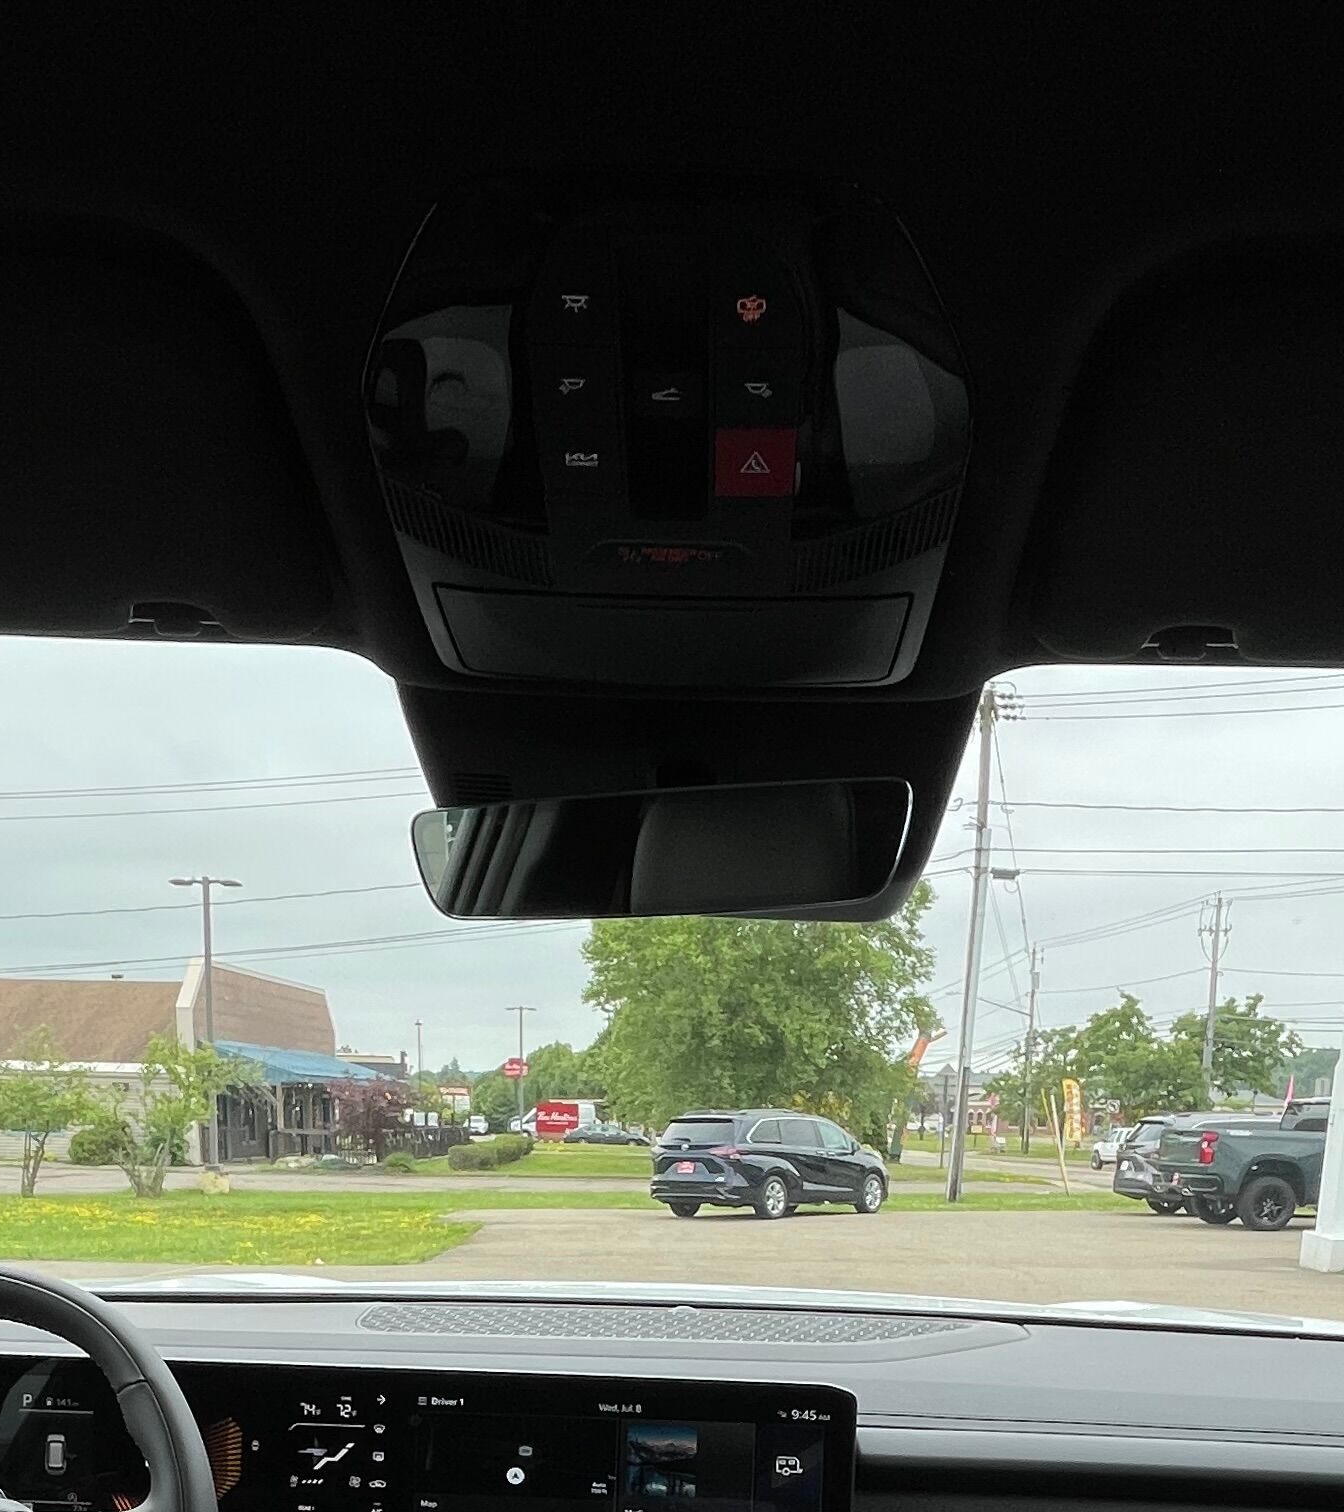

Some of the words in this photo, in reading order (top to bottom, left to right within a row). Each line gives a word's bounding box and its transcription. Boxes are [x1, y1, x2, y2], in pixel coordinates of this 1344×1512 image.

[23, 1394, 32, 1406] P
[430, 1396, 458, 1406] Driver
[790, 1409, 818, 1421] 9:45
